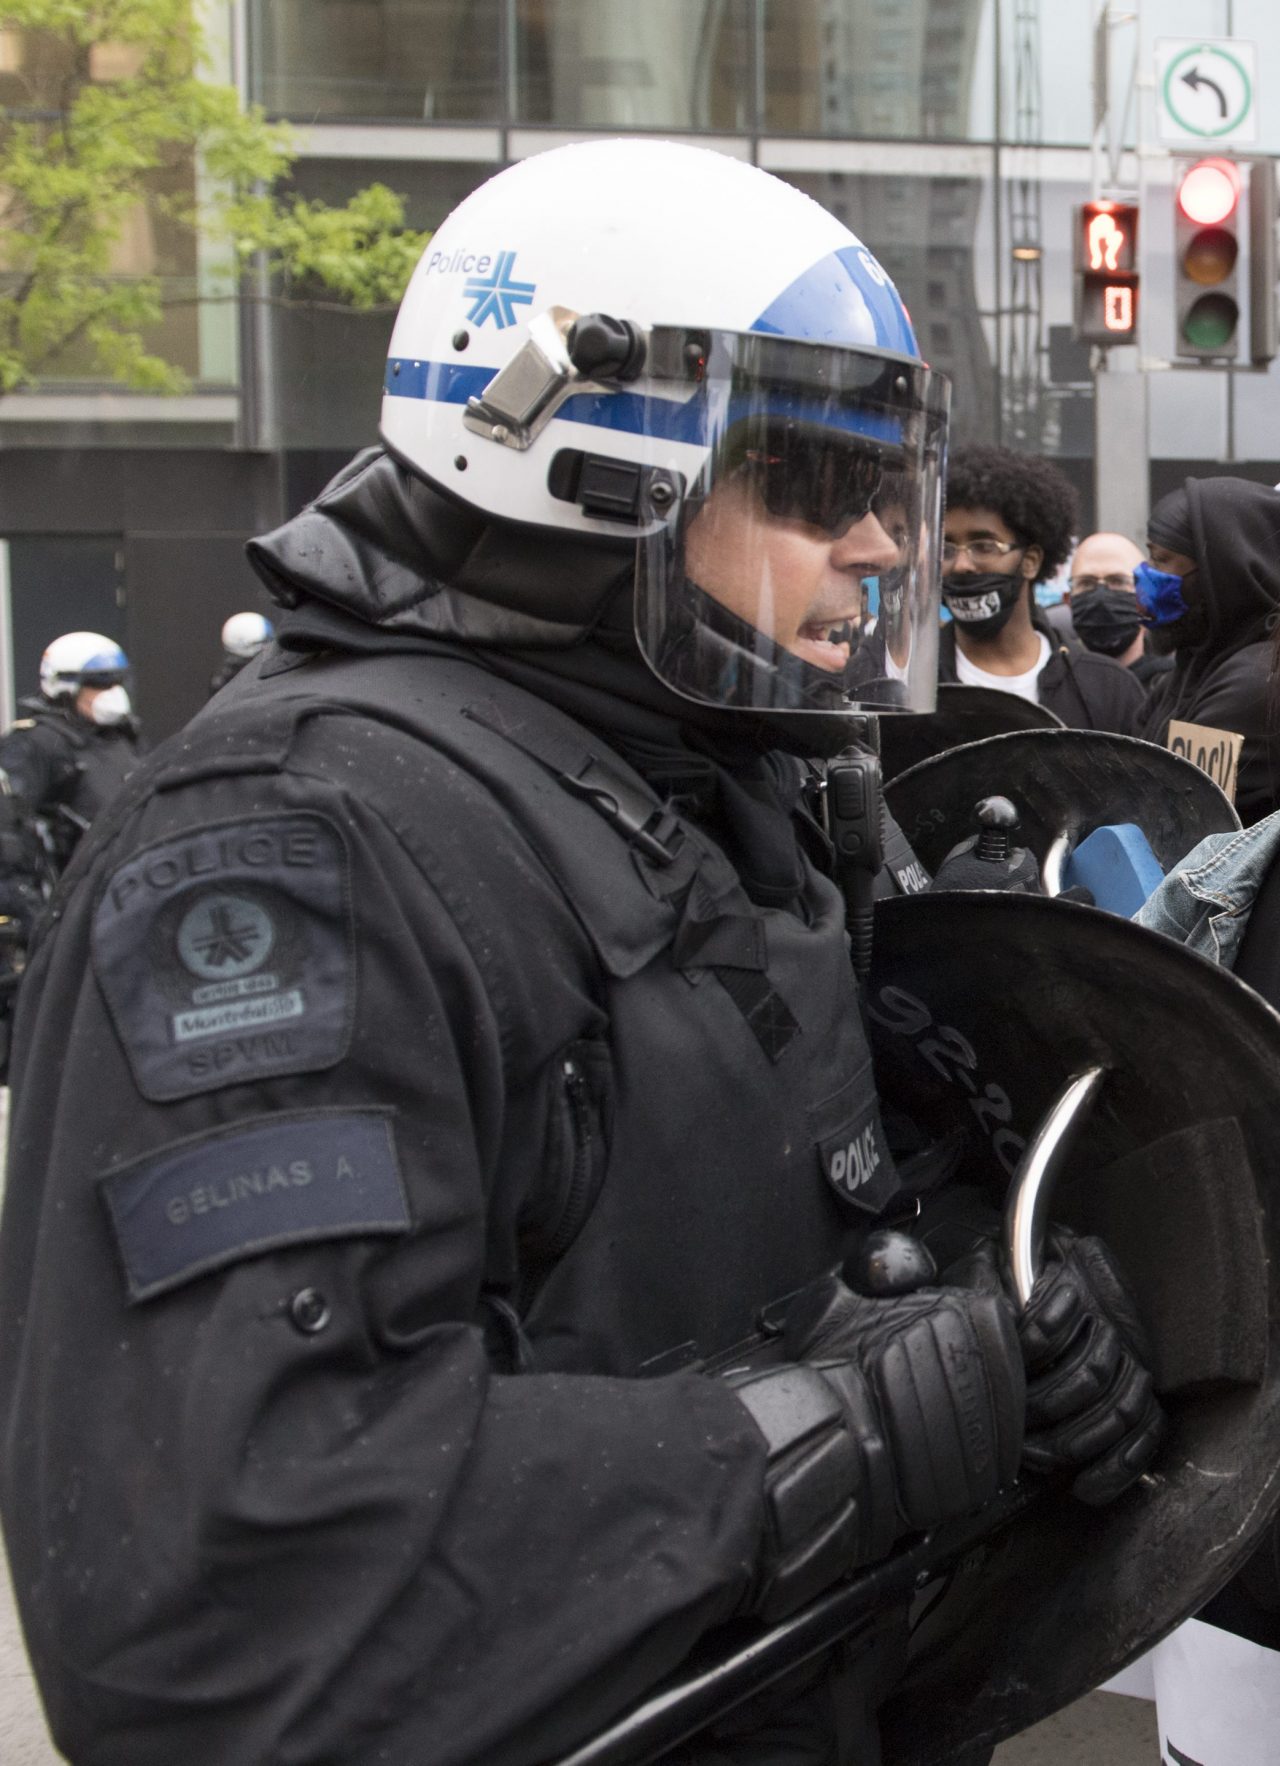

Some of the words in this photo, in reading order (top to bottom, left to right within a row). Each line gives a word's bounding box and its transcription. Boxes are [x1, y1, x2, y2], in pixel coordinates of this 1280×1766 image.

[428, 248, 491, 273] Police
[1105, 287, 1132, 329] 0
[110, 831, 316, 913] POLICE
[188, 1031, 298, 1077] SPVM
[167, 1160, 314, 1225] GELINAS
